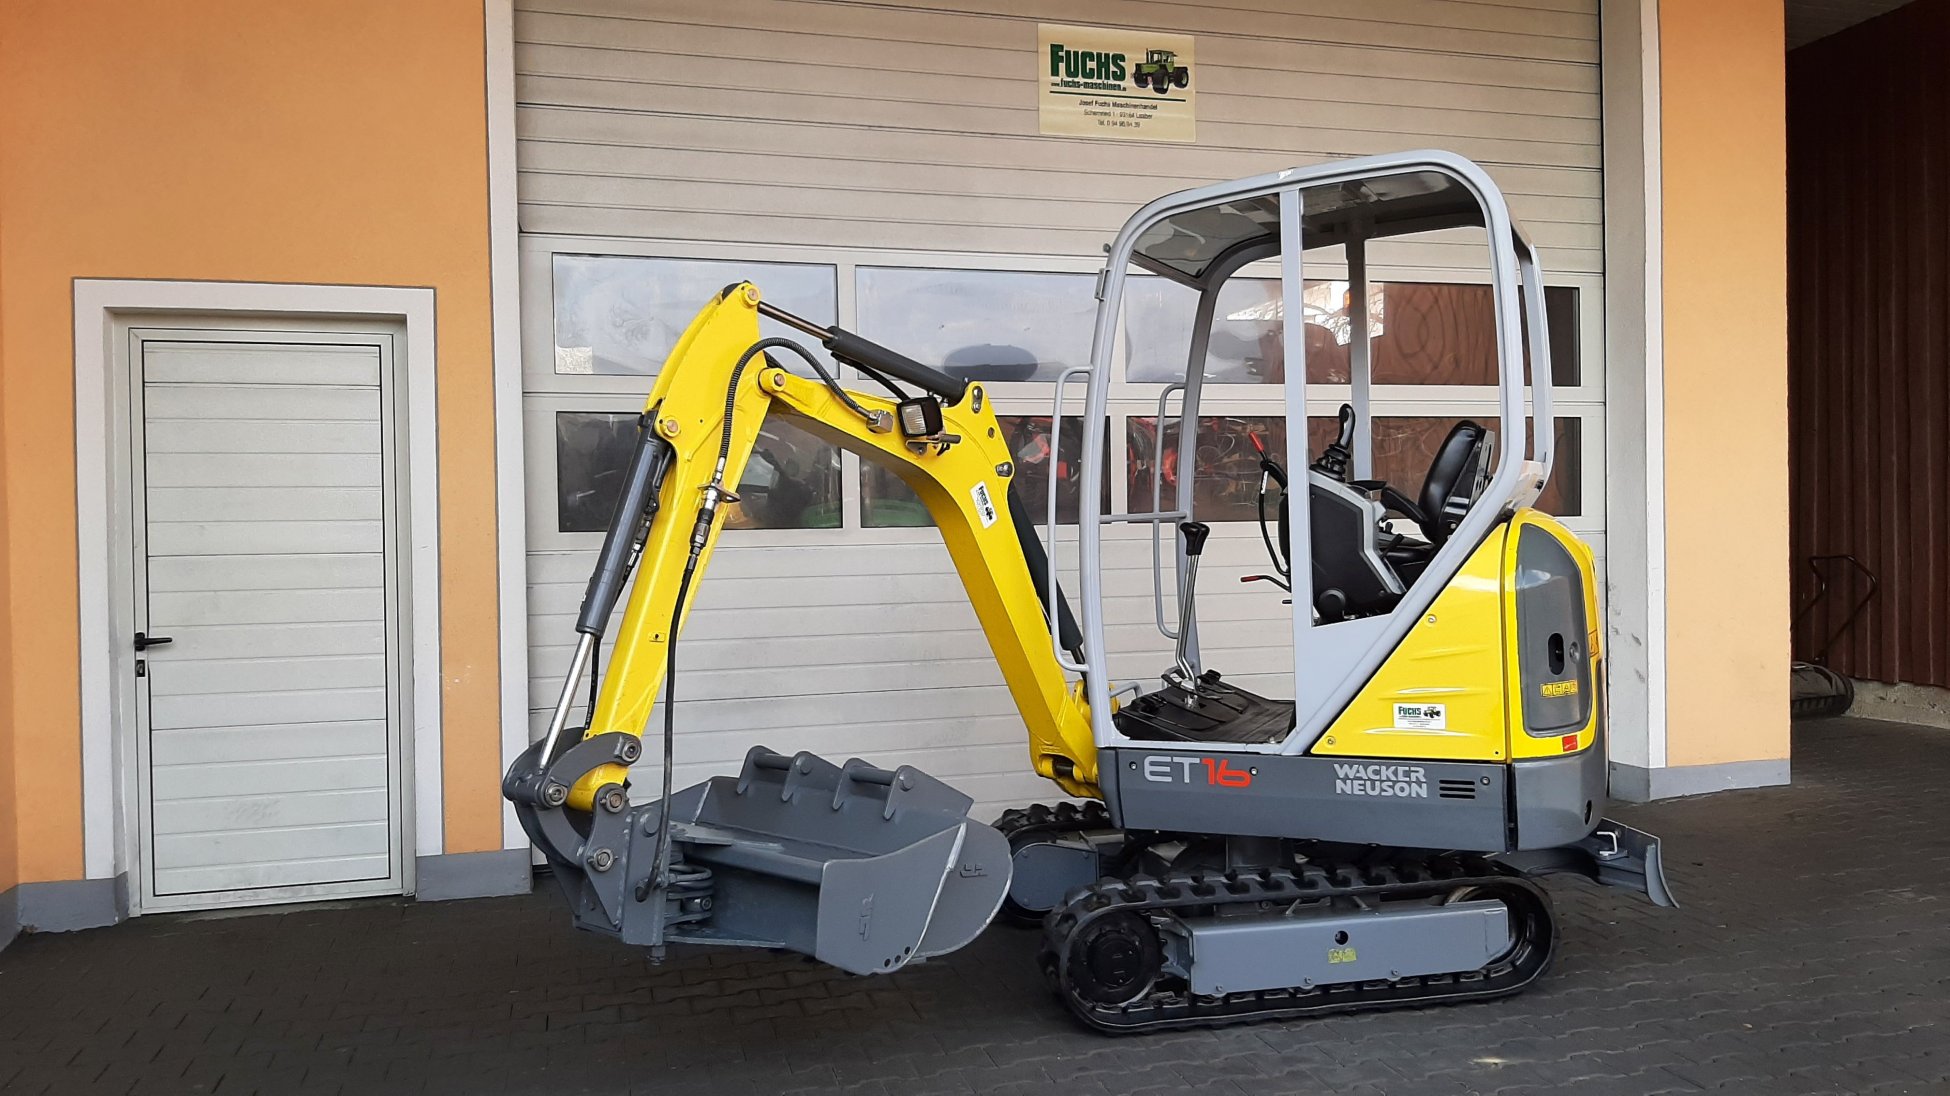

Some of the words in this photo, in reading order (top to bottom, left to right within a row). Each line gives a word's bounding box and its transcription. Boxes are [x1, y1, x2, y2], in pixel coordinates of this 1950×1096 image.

[1050, 43, 1126, 82] FUCHS
[1112, 101, 1158, 110] Maschinenhandel
[1398, 706, 1421, 716] FUCHS
[1144, 755, 1252, 787] ET16
[1333, 763, 1427, 782] WACKER
[1335, 779, 1428, 798] NEUSON
